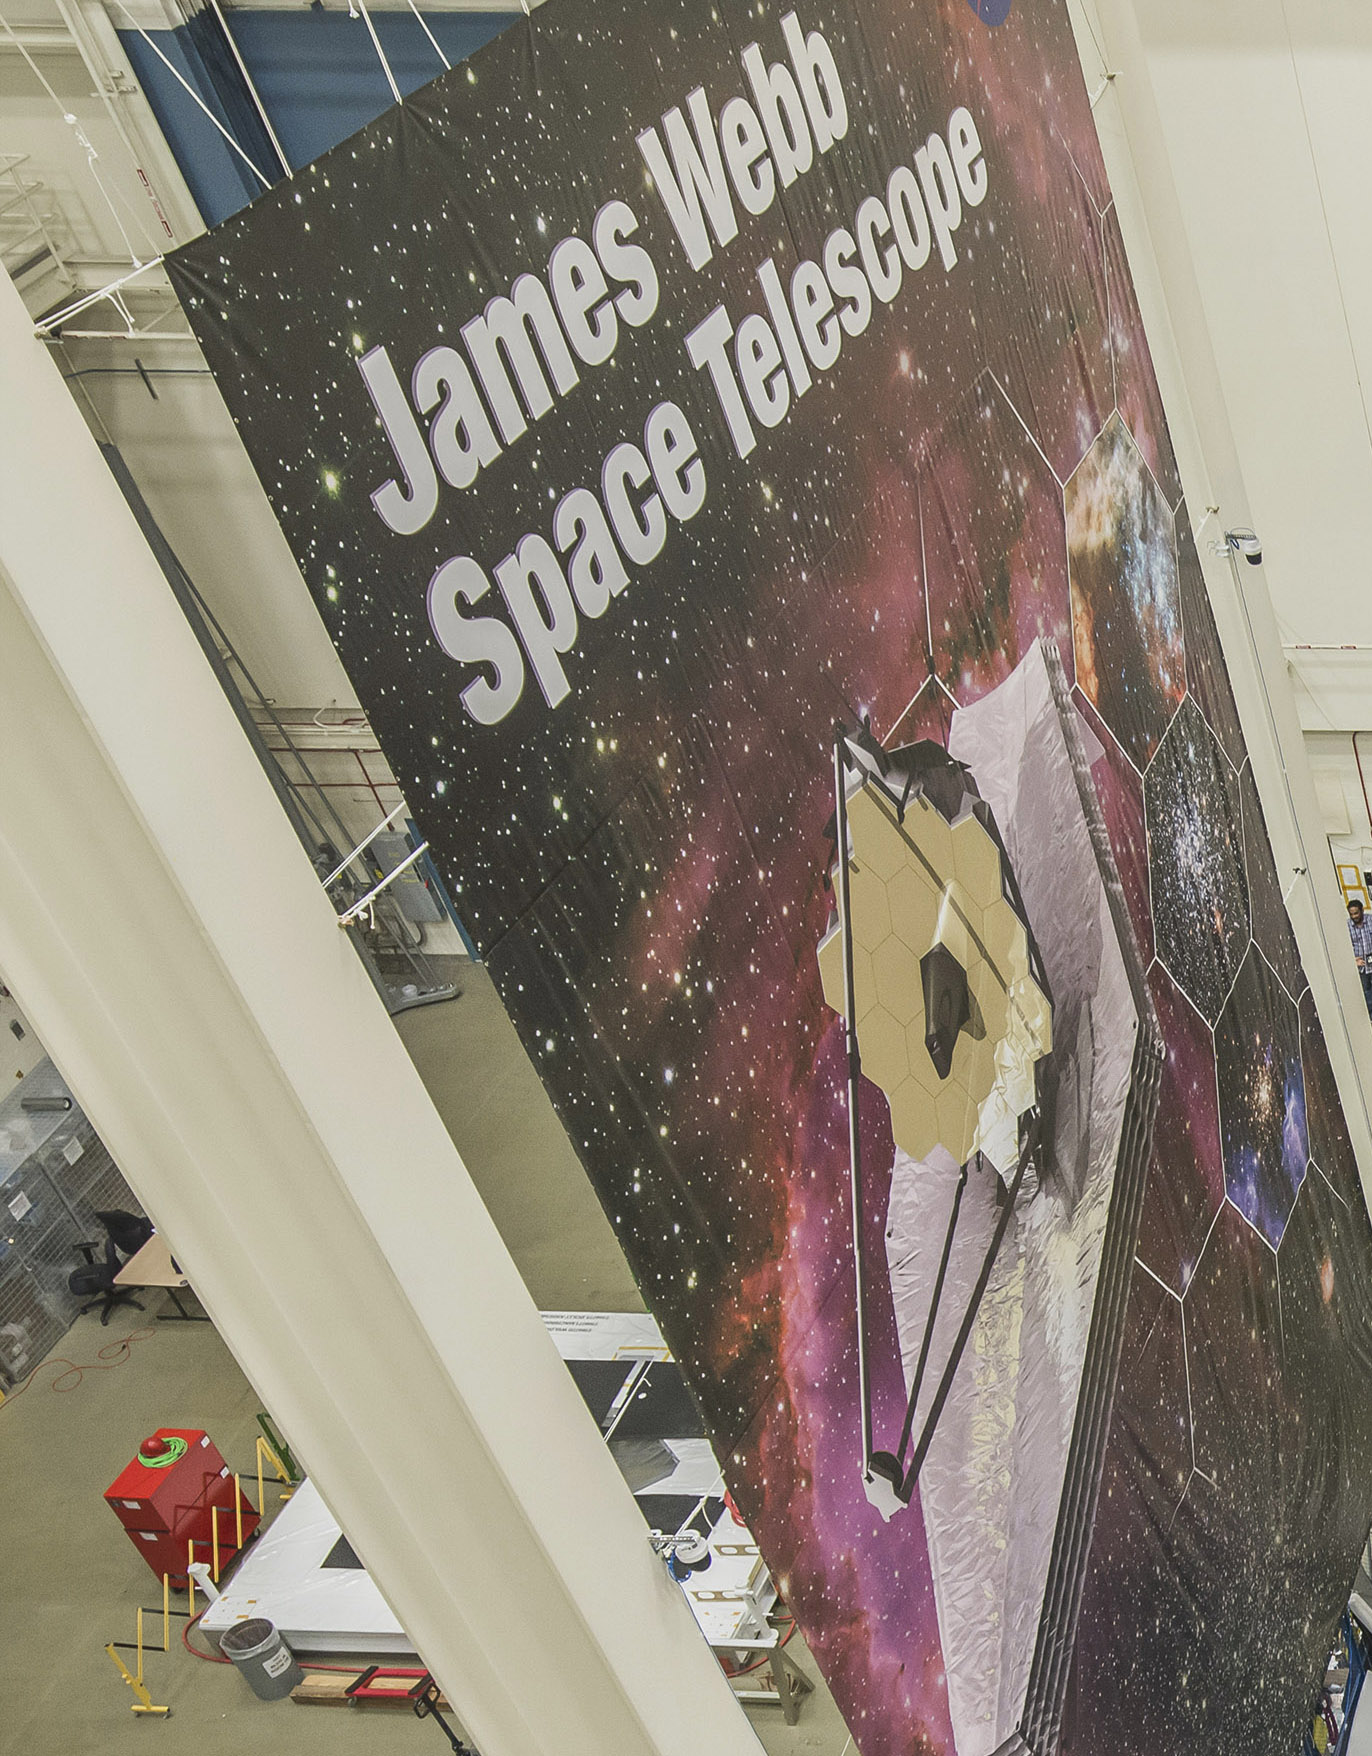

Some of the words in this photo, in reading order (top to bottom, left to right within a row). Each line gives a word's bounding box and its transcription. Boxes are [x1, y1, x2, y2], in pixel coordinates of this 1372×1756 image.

[357, 200, 659, 535] James
[635, 10, 848, 272] Webb
[427, 401, 706, 725] Space
[684, 106, 989, 460] Telescope
